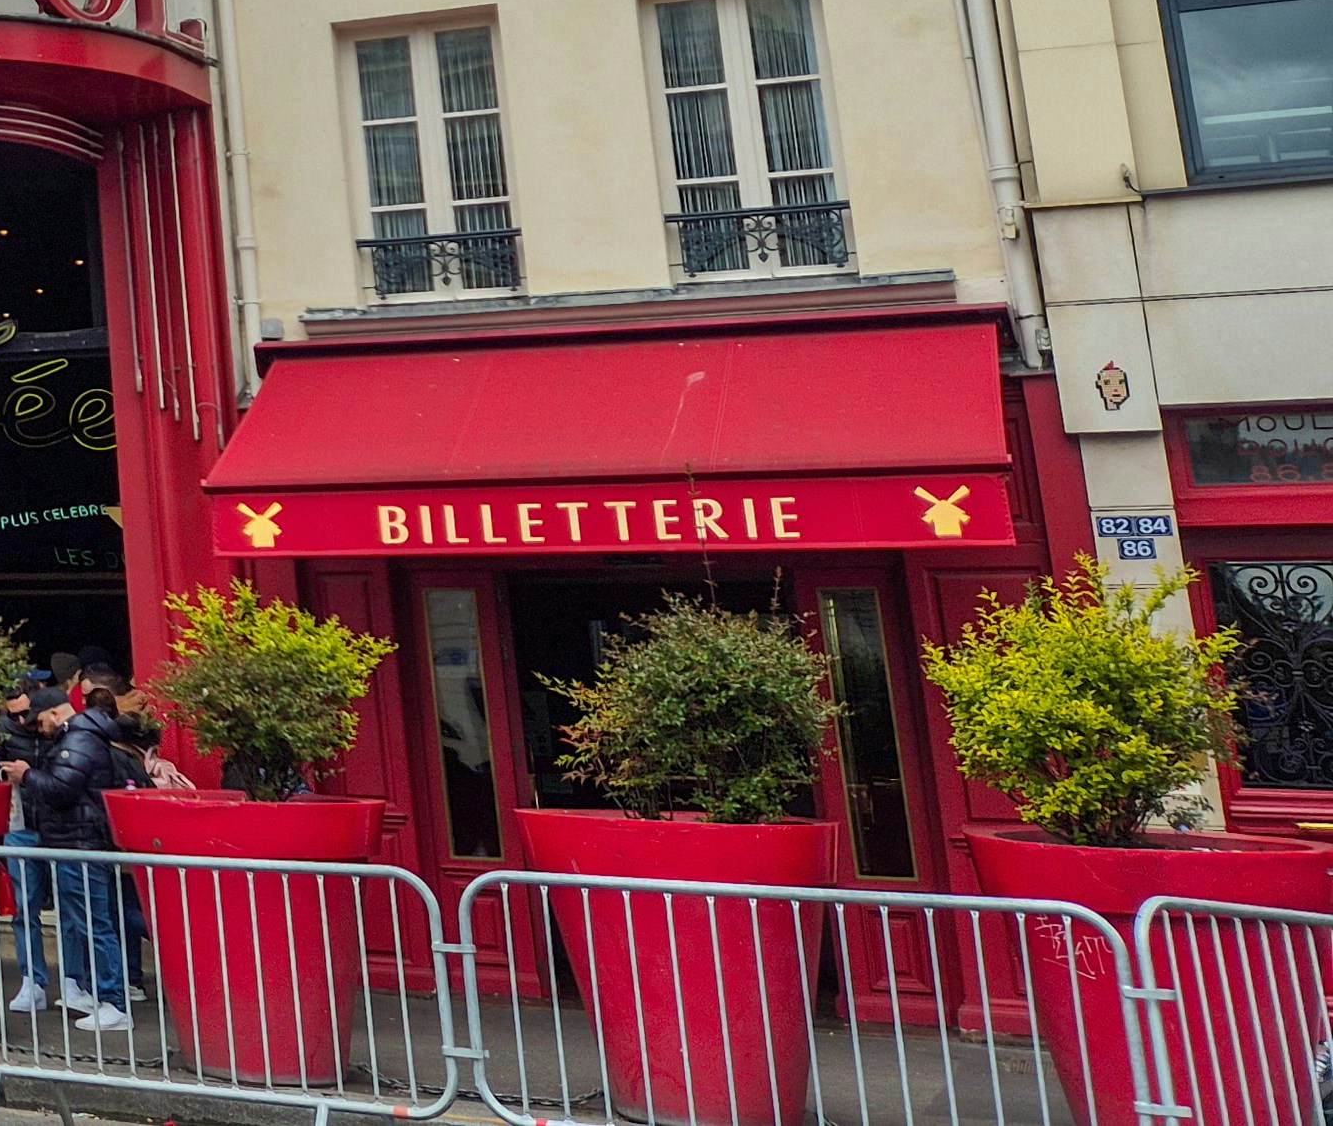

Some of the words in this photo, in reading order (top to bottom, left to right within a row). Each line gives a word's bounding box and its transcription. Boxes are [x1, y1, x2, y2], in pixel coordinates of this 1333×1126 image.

[1, 512, 40, 530] PLUS
[377, 496, 802, 545] BILLETTERIE
[1101, 518, 1130, 534] 82
[1138, 518, 1168, 534] 84
[1122, 540, 1152, 556] 86
